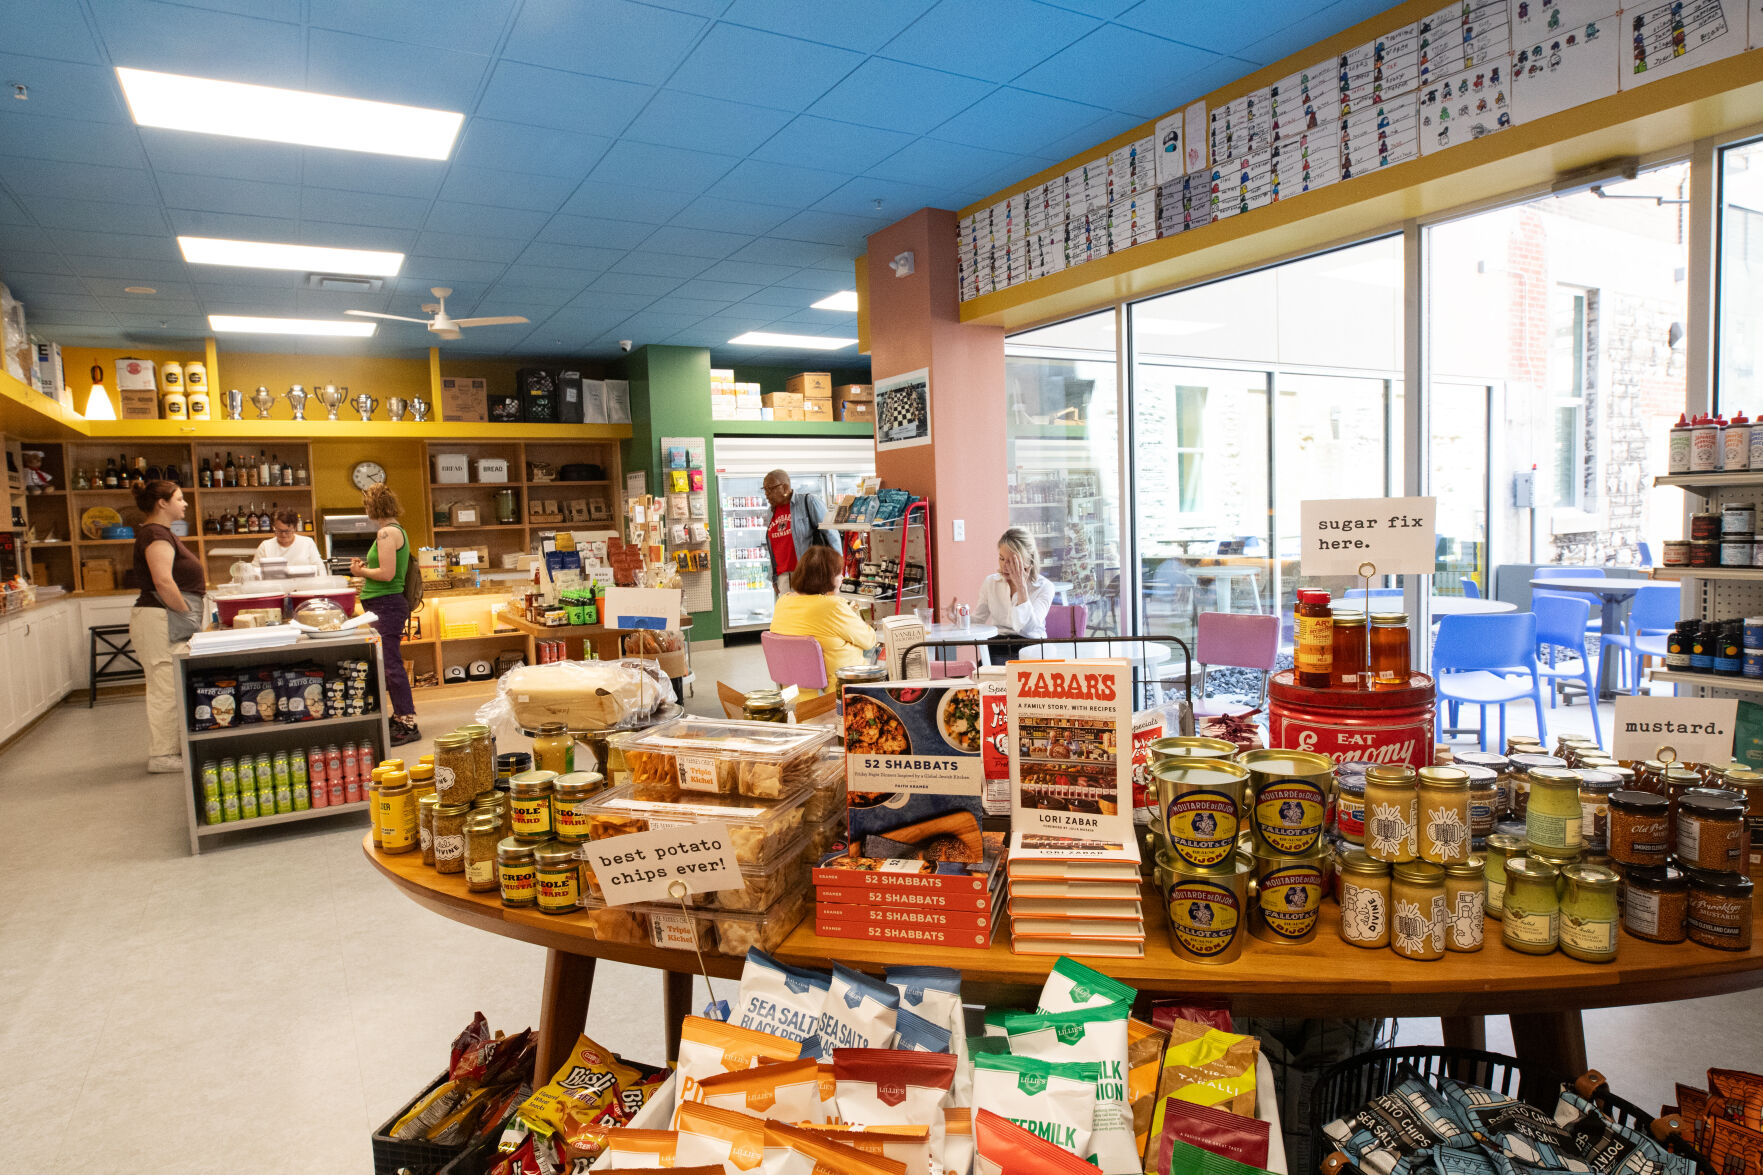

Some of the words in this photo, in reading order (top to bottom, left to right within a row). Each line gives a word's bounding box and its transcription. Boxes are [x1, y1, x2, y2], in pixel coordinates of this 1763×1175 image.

[1318, 517, 1378, 532] sugar
[1387, 515, 1424, 529] fix
[1318, 537, 1371, 550] here.
[1089, 705, 1117, 713] RECIPES
[1131, 717, 1159, 731] pecials
[1625, 719, 1724, 735] mustard.
[1337, 733, 1376, 745] EAT
[865, 759, 880, 769] 52
[885, 759, 958, 771] SHABBATS
[690, 767, 712, 777] Triple
[1260, 790, 1299, 801] MOUTARDE
[1172, 801, 1210, 814] MOUTARDE
[1217, 803, 1234, 814] DIJON
[1039, 814, 1061, 824] LORI
[1065, 816, 1098, 827] ZABAR
[1261, 824, 1301, 836] FALLOT
[1174, 836, 1215, 848] FALLOT
[1271, 838, 1310, 851] DIJON
[599, 849, 646, 867] best
[655, 839, 722, 860] potato
[1184, 851, 1223, 864] DIJON
[611, 868, 668, 886] chips
[676, 857, 726, 875] ever!
[865, 874, 879, 884] 52
[881, 875, 942, 887] SHABBATS
[1265, 875, 1304, 887] MOUTARDE
[869, 892, 882, 901] 52
[885, 893, 946, 906] SHABBATS
[1172, 890, 1207, 900] MOUTARDE
[1214, 894, 1234, 905] DIJON
[1697, 900, 1742, 914] Brooklyn
[869, 911, 883, 920] 52
[886, 911, 947, 924] SHABBATS
[1264, 909, 1304, 920] FALLOT
[1367, 898, 1380, 932] DIVINE
[666, 925, 692, 935] Triple
[868, 927, 881, 936] 52
[884, 928, 945, 941] SHABBATS
[1174, 923, 1213, 938] FALLOT
[1275, 923, 1311, 935] DIJON
[1183, 938, 1222, 952] DIJON
[747, 996, 777, 1022] SEA
[778, 1006, 818, 1036] SALT
[819, 1012, 840, 1037] SEA
[838, 1024, 864, 1050] SALT
[1057, 1025, 1084, 1036] LILLIE'S
[559, 1067, 617, 1098] Bissli
[1020, 1076, 1047, 1085] LILLIE'S
[1178, 1072, 1239, 1097] TARALLI
[878, 1087, 905, 1096] LILLIE'S
[1356, 1111, 1376, 1129] SEA
[1374, 1125, 1398, 1149] SALT
[1401, 1119, 1431, 1148] CHIPS
[1514, 1122, 1535, 1139] SEA
[732, 1147, 762, 1160] LILLIE'S
[1212, 1141, 1228, 1149] GREAT
[1228, 1145, 1243, 1153] TASTE
